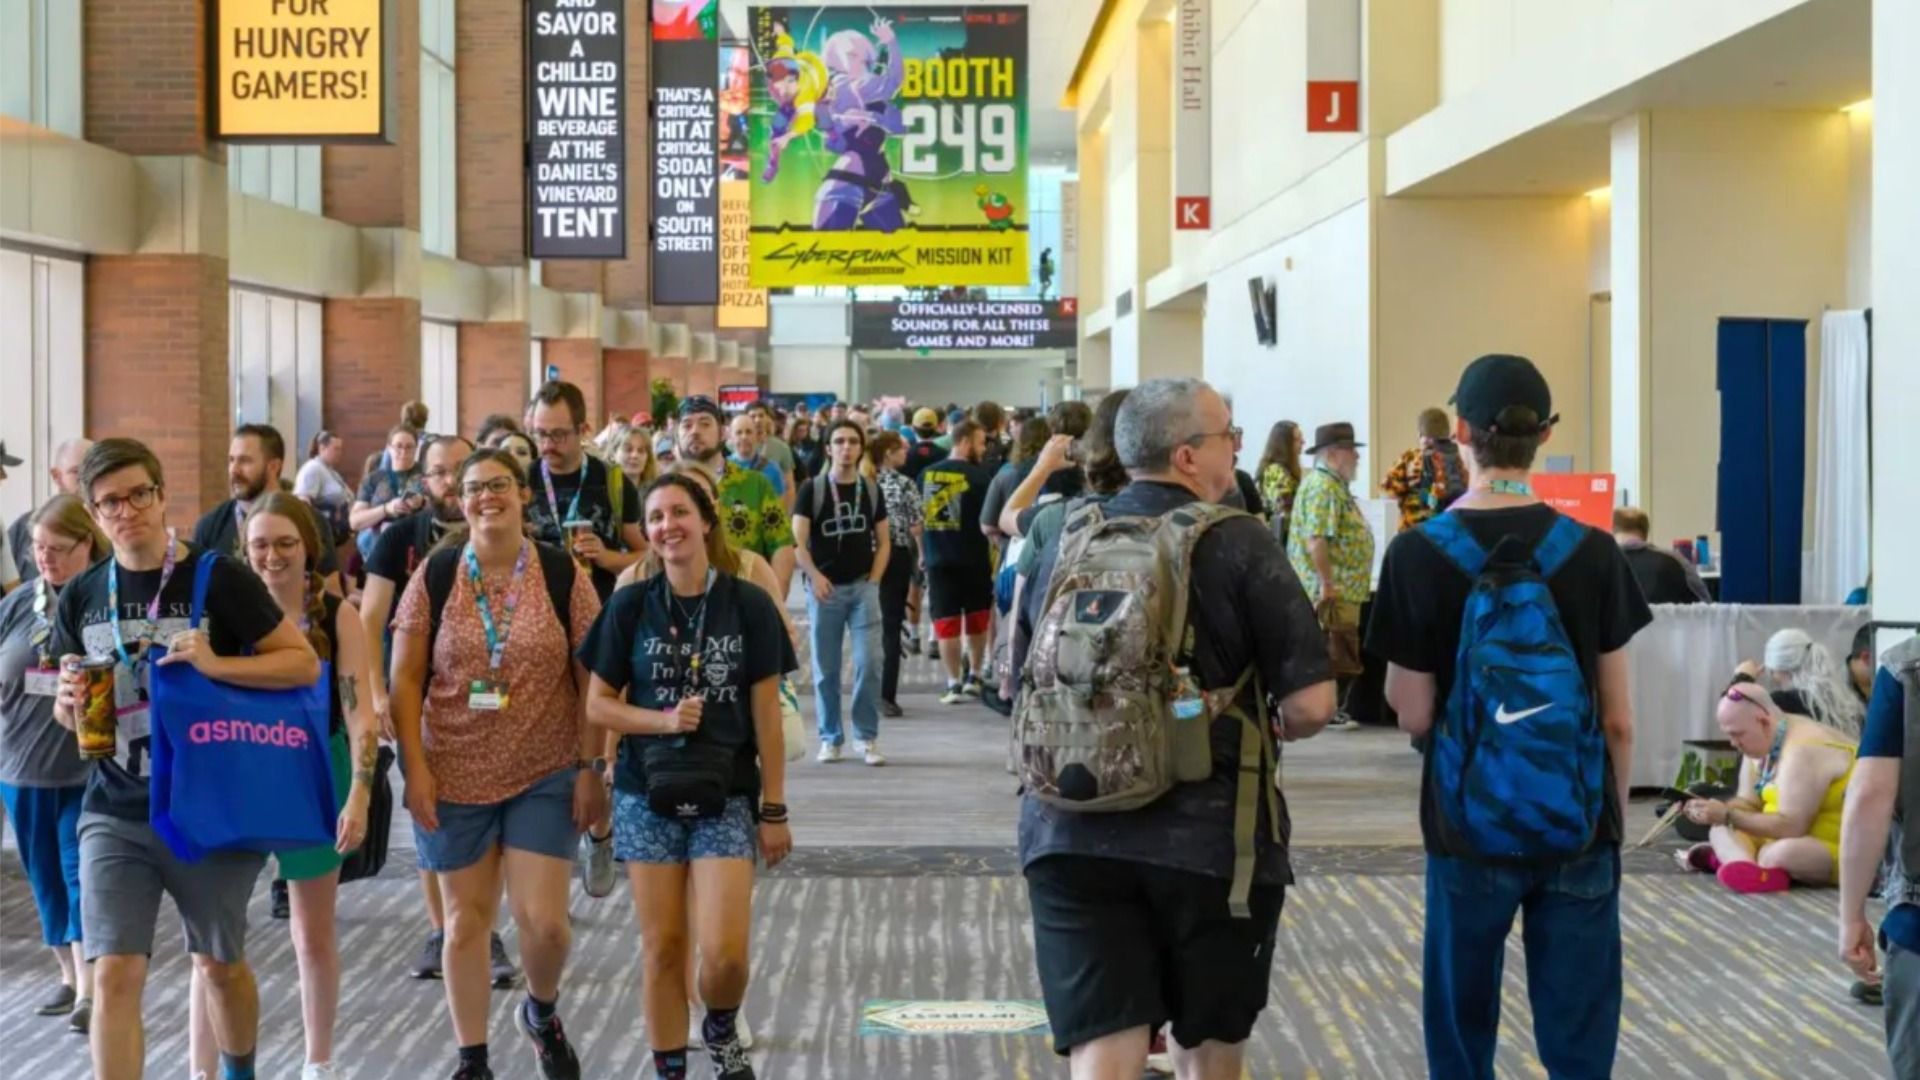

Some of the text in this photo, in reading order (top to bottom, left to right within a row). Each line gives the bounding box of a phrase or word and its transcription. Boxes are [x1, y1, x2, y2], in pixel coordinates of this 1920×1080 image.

[536, 11, 617, 36] SAVOR
[234, 27, 370, 58] HUNGRY
[569, 39, 584, 57] A
[537, 62, 617, 82] CHILLED
[903, 58, 1013, 98] BOOTH
[231, 70, 367, 99] GAMERS!
[1183, 67, 1201, 110] Hall
[537, 87, 617, 117] WINE
[656, 88, 714, 102] THAT'S A
[657, 105, 714, 118] CRITICAL
[1325, 91, 1340, 123] J
[537, 120, 618, 136] BEVERAGE
[657, 120, 714, 139] HIT AT
[902, 104, 1016, 173] 249
[548, 140, 606, 159] AT THE
[657, 141, 714, 155] CRITICAL
[538, 163, 617, 181] DANIEL'S
[656, 157, 713, 175] SODA!
[537, 185, 617, 202] VINEYARD
[657, 177, 714, 198] ONLY
[676, 200, 695, 213] ON
[1183, 203, 1200, 224] K
[537, 206, 618, 238] TENT
[657, 216, 713, 234] SOUTH
[657, 236, 713, 252] STREET!
[722, 245, 738, 260] OF
[916, 247, 982, 265] MISSION
[988, 247, 1013, 265] KIT
[722, 263, 751, 277] FRO
[722, 292, 764, 307] PIZZA
[952, 319, 980, 332] FOR
[982, 319, 1006, 332] ALL
[1010, 319, 1050, 332] THESE
[906, 334, 1035, 348] GAMES AND MORE!
[704, 634, 743, 654] Me!
